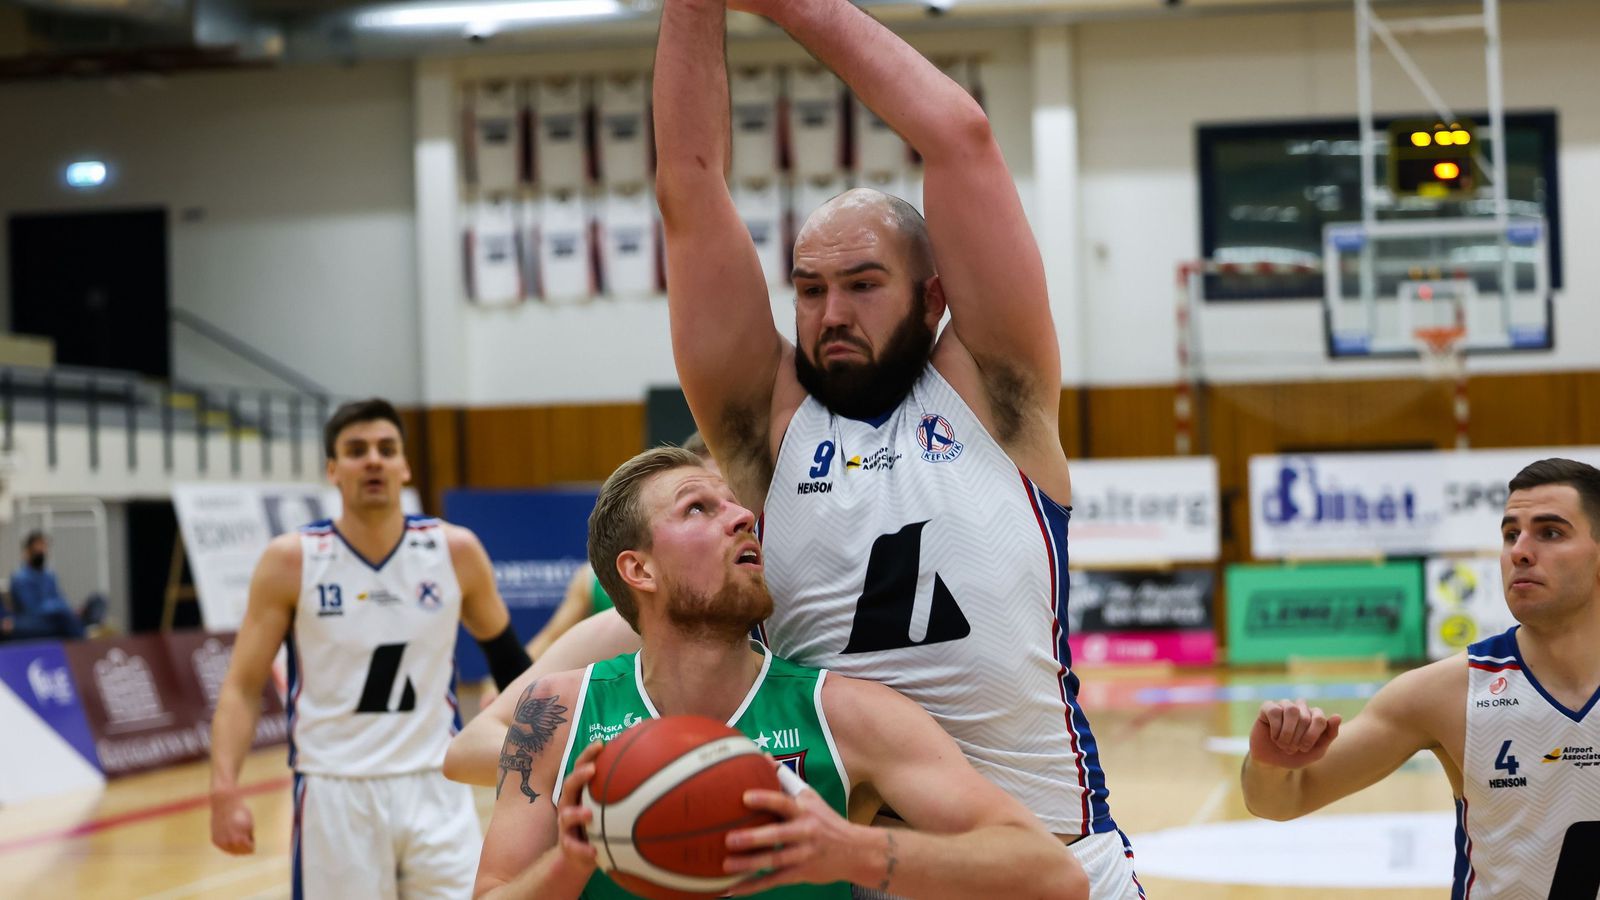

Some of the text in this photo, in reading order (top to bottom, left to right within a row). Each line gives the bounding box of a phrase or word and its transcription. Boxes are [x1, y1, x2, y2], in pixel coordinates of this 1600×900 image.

[809, 440, 836, 479] 9
[924, 442, 961, 461] KEFLAVIK
[797, 481, 833, 494] HENSON
[317, 583, 342, 607] 13
[1476, 698, 1519, 708] HS ORKA
[772, 728, 800, 749] XIII
[1495, 739, 1520, 776] 4
[1563, 746, 1593, 754] Airport
[1489, 777, 1527, 789] HENSON
